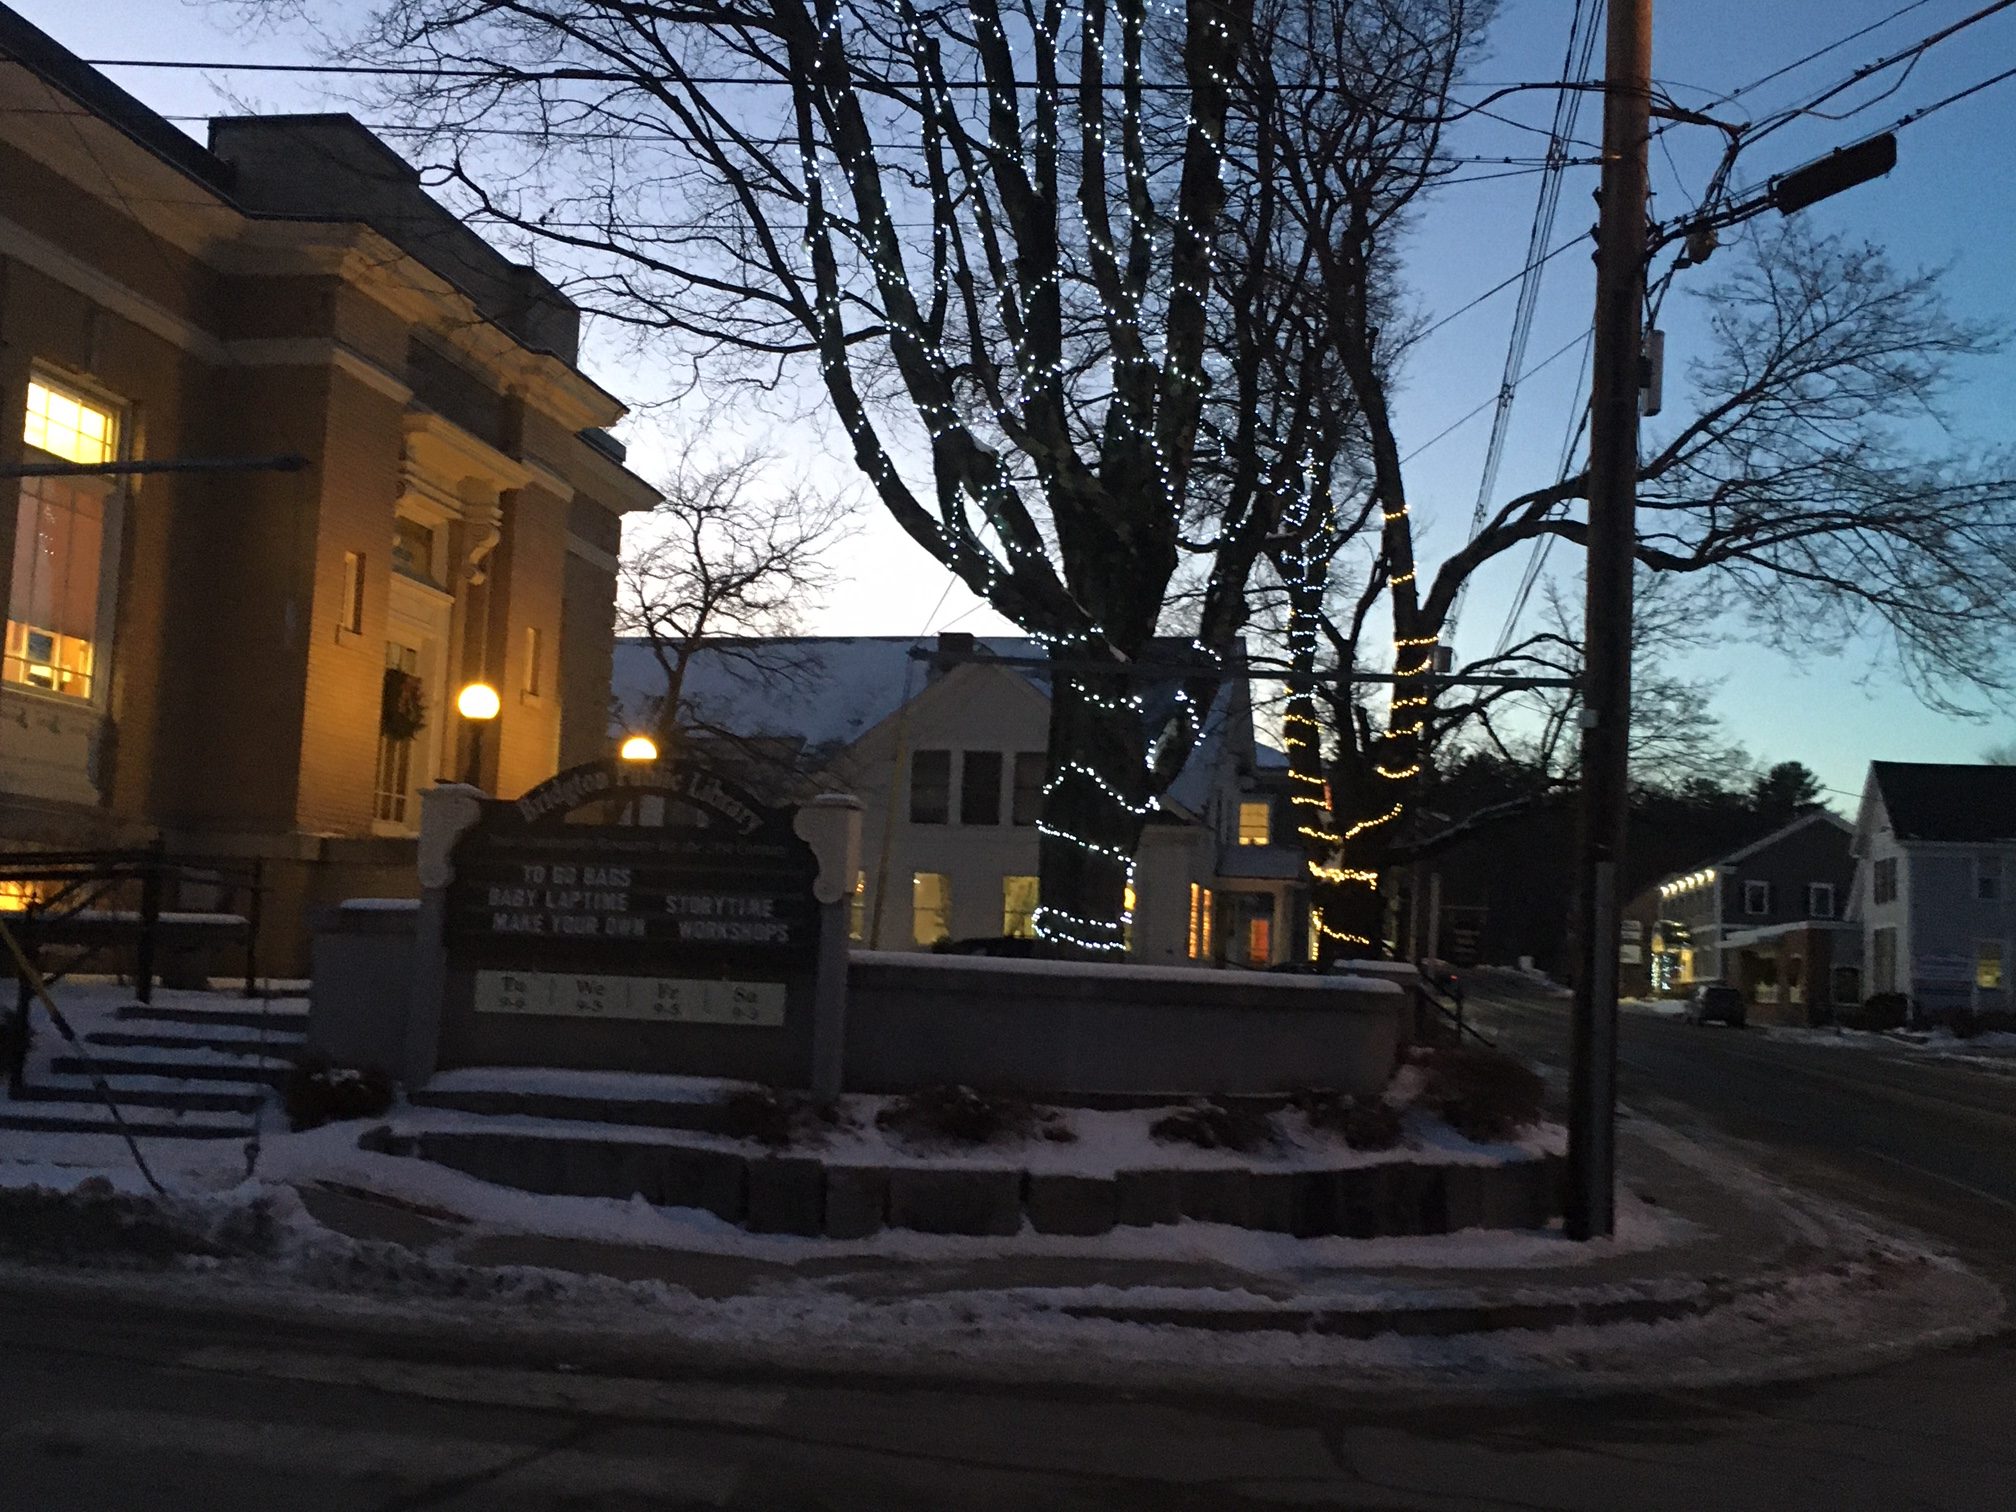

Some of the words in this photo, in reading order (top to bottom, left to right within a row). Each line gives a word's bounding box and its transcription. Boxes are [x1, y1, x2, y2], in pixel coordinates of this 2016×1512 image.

[523, 865, 546, 883] TO
[488, 887, 536, 907] BABY
[545, 890, 628, 911] LAPTIME
[665, 895, 774, 918] STORYTIME
[492, 913, 543, 934] MAKE
[551, 916, 598, 935] YOUR
[605, 917, 645, 936] OWN
[679, 921, 790, 942] WORKSHOPS
